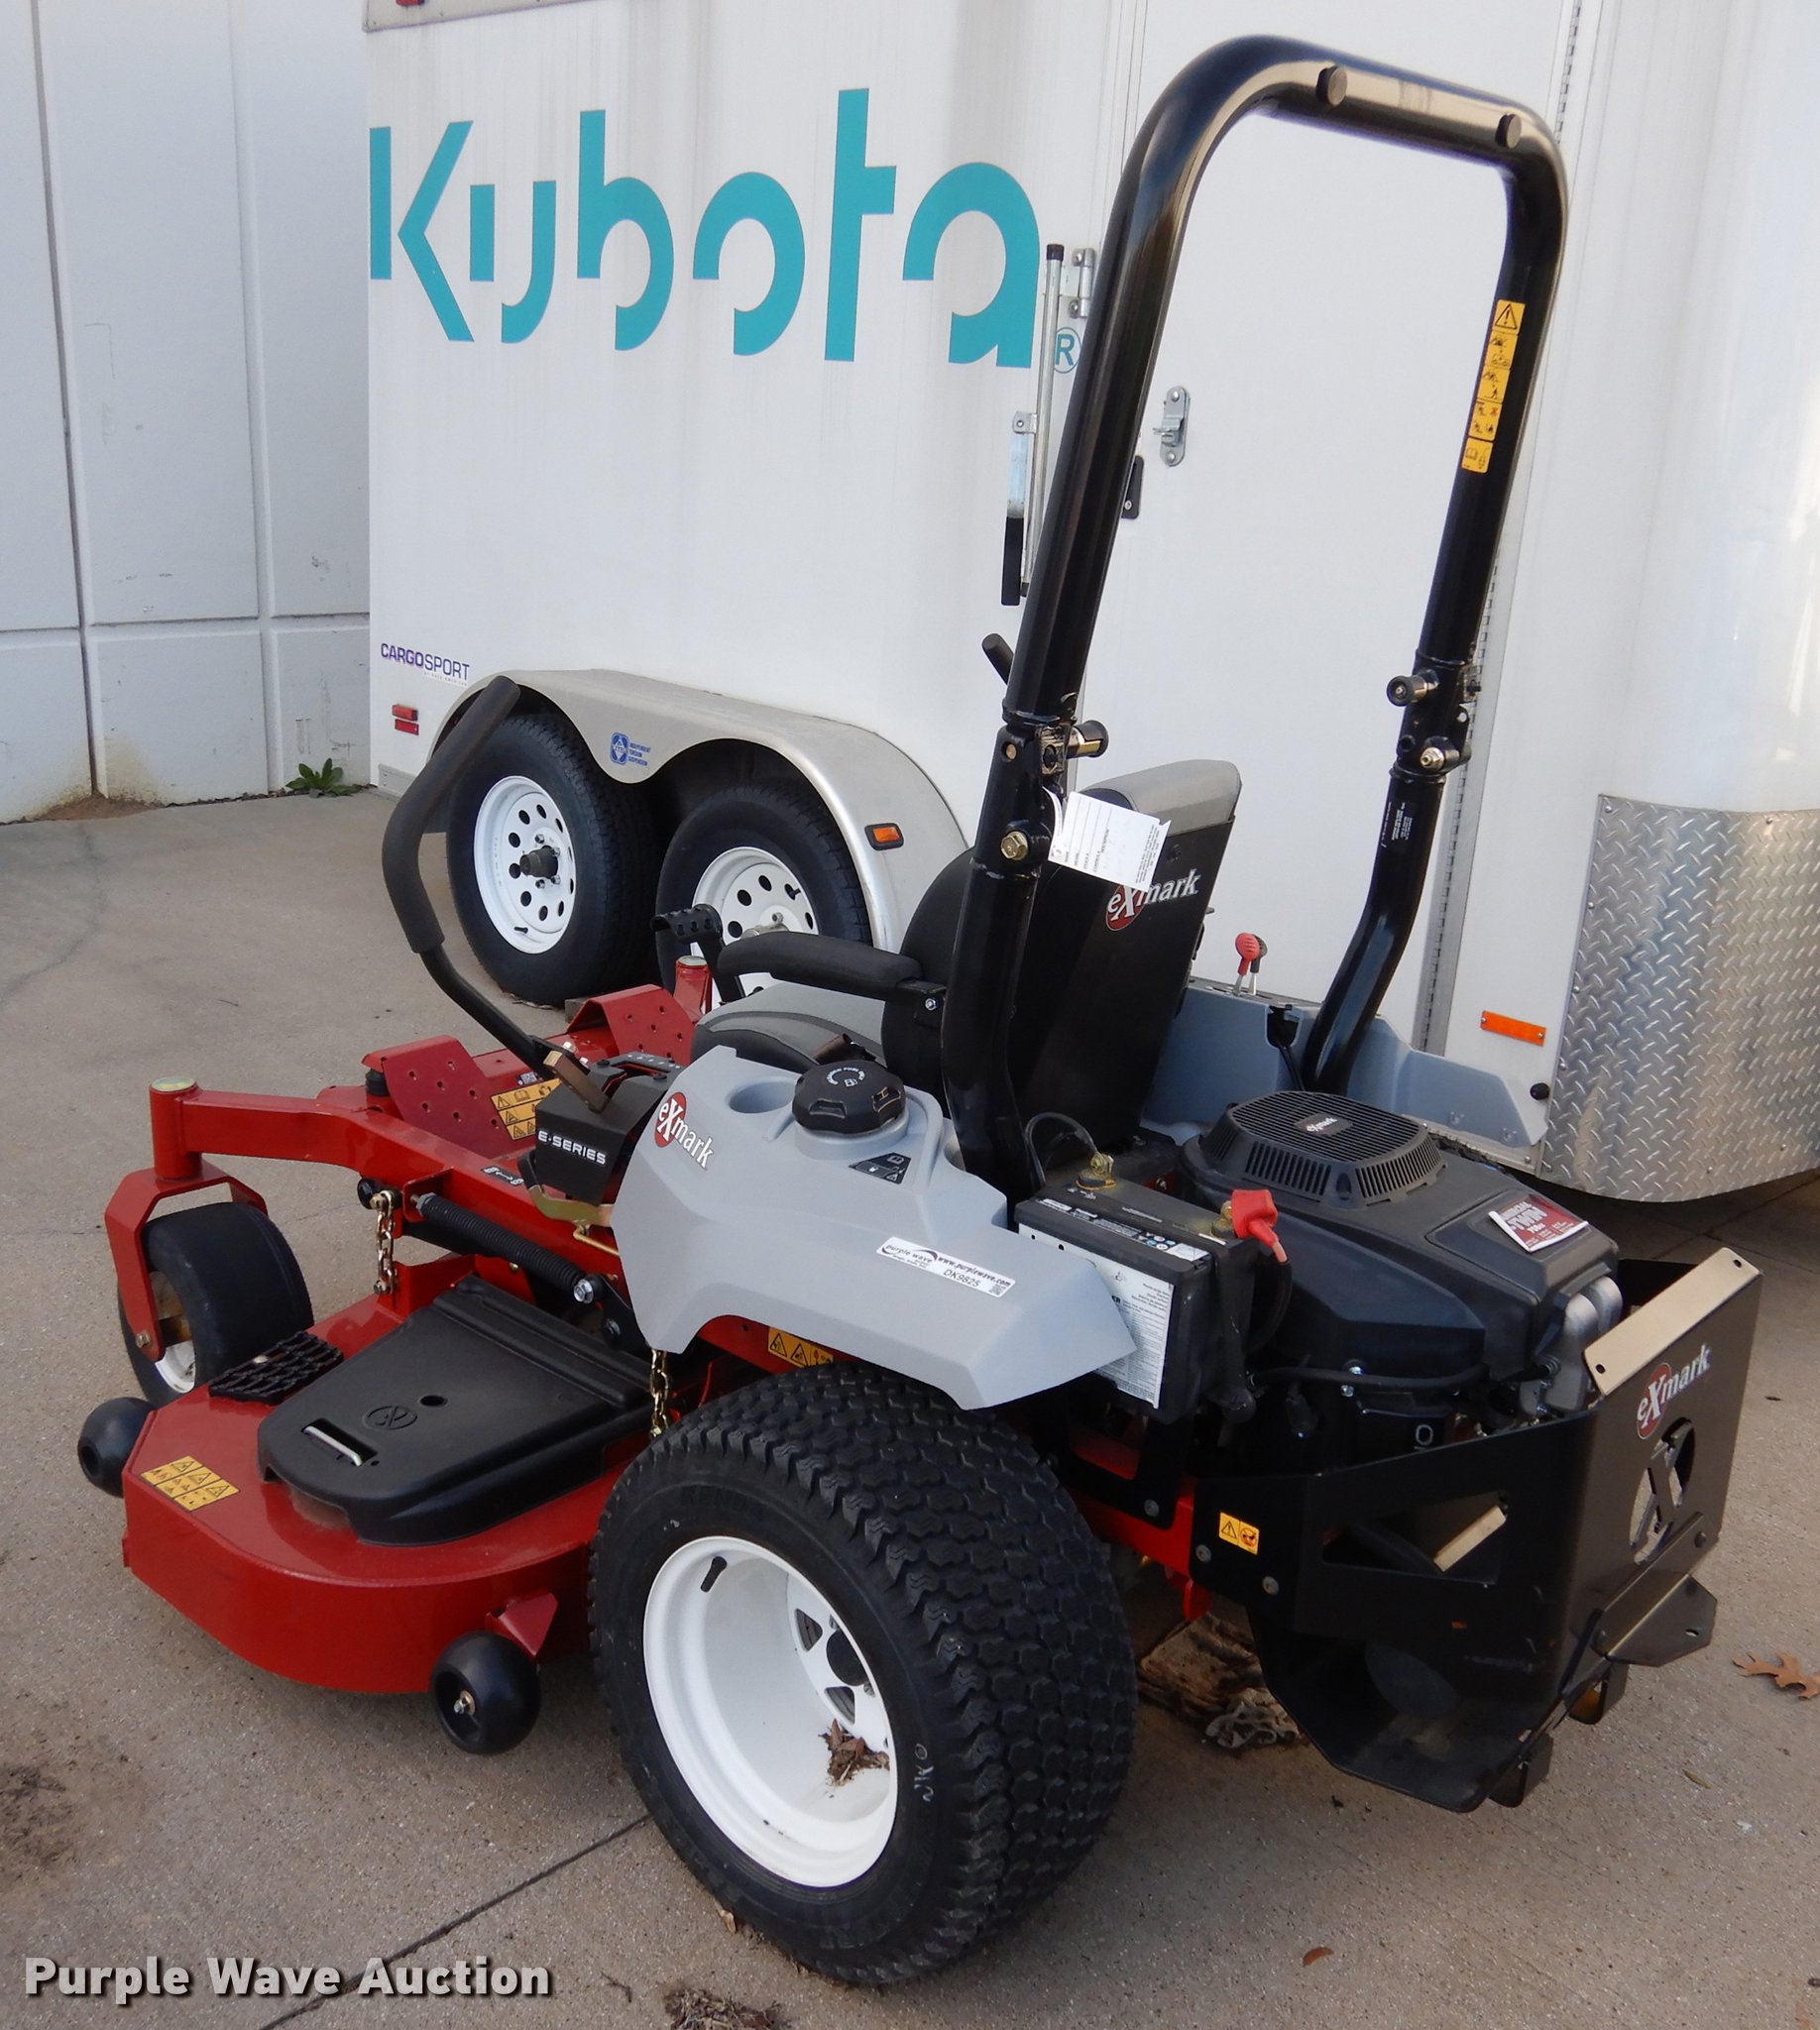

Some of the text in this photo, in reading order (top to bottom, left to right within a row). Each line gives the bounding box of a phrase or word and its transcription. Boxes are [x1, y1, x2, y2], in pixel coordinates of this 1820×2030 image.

[369, 88, 1040, 369] Kubota
[381, 642, 470, 681] CARGOSPORT
[943, 1269, 980, 1287] DK9825
